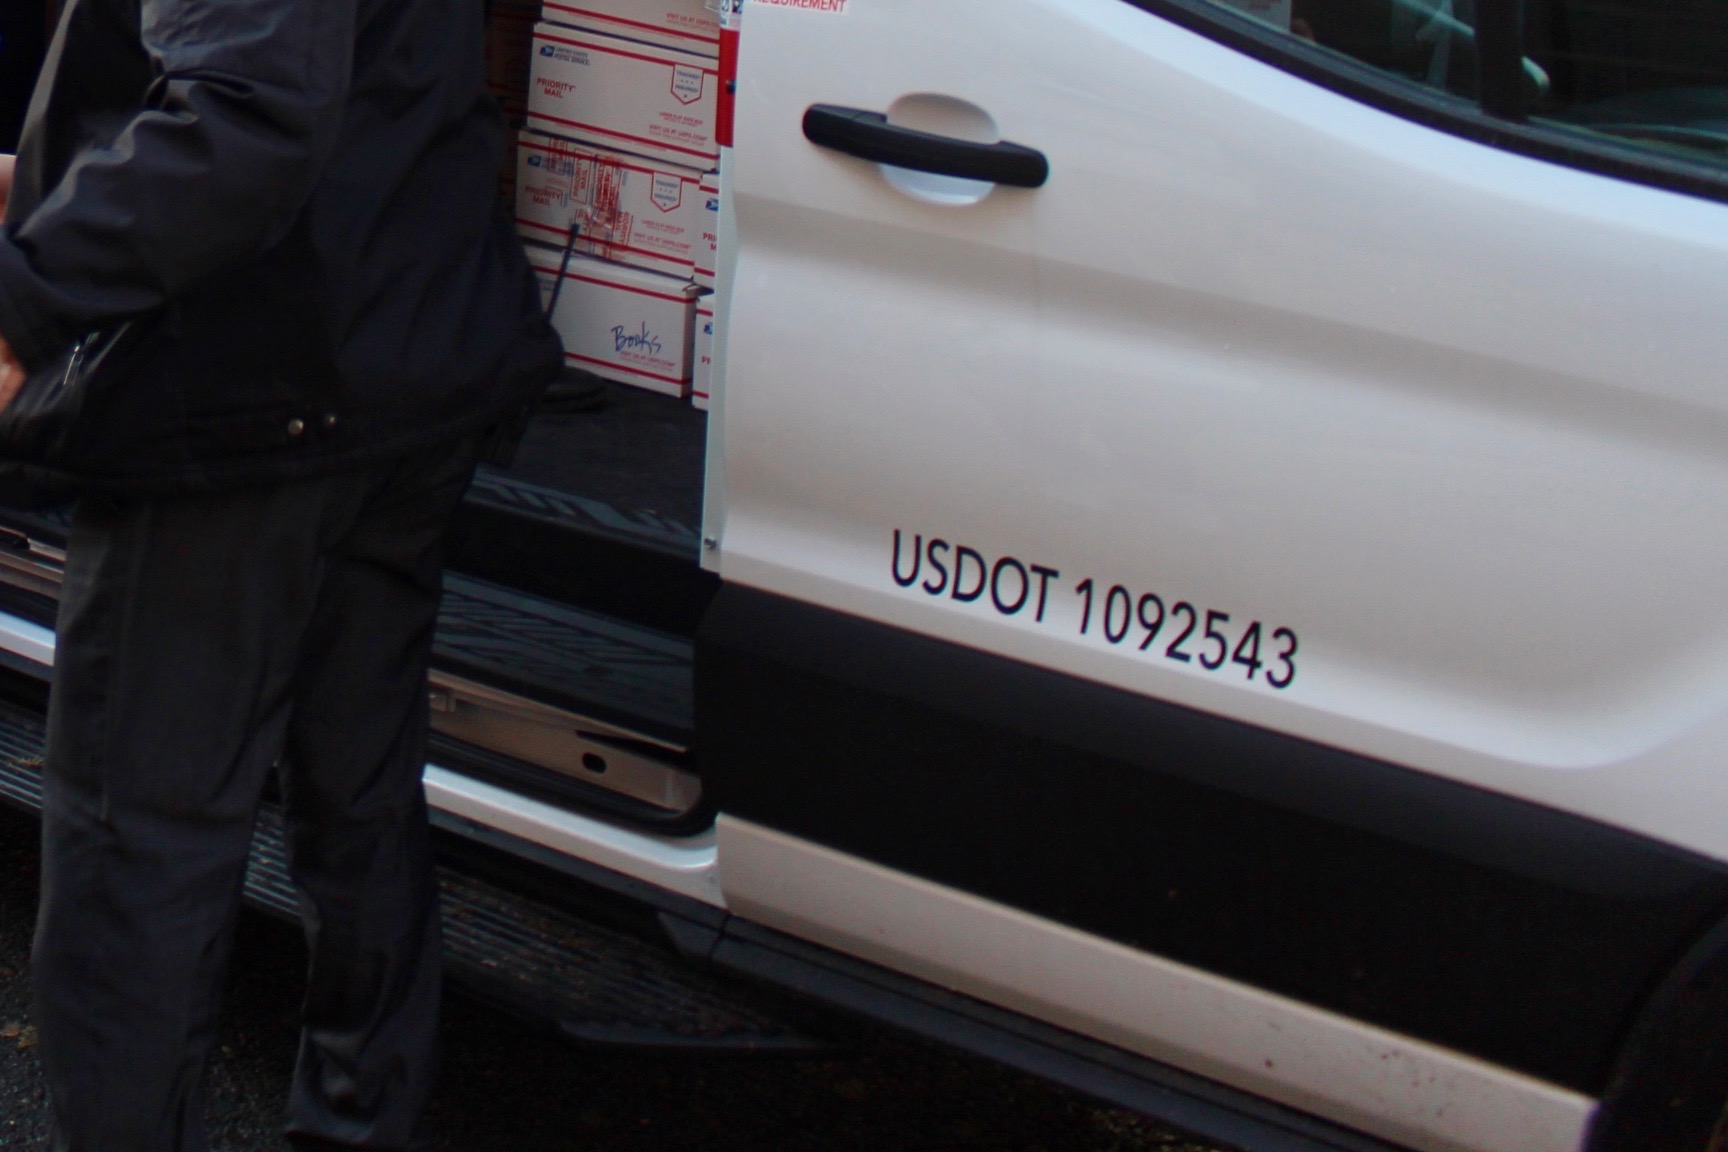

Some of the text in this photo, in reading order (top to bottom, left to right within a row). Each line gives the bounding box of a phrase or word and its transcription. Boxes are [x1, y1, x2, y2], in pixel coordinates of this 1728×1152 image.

[544, 88, 563, 98] MAIL
[611, 320, 661, 353] Books
[891, 528, 1299, 689] USDOT 1092543
